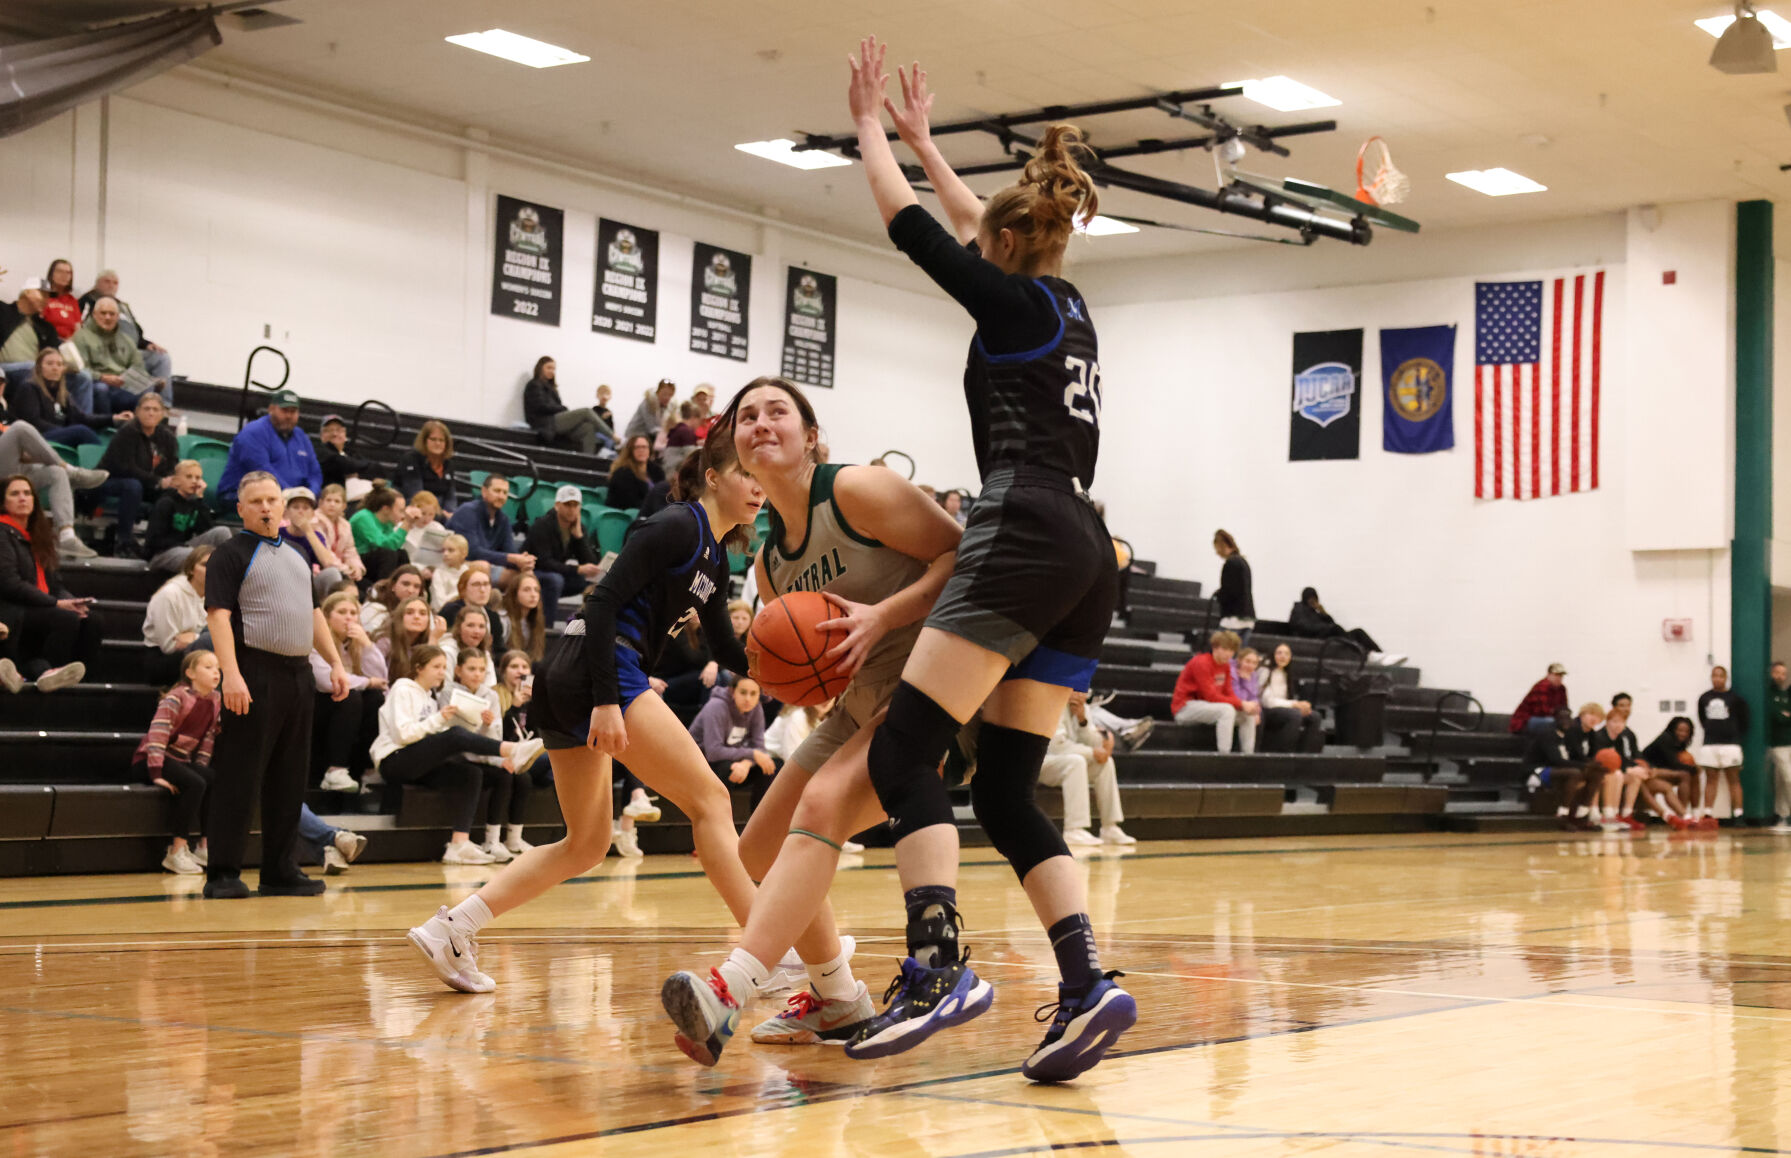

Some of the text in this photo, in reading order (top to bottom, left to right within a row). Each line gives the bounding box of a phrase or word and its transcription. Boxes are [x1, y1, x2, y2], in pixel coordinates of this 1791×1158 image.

[505, 249, 538, 268] REGION
[502, 263, 552, 285] CHAMPIONS
[601, 282, 648, 304] CHAMPIONS
[513, 299, 539, 316] 2022
[785, 547, 847, 593] NTRAL
